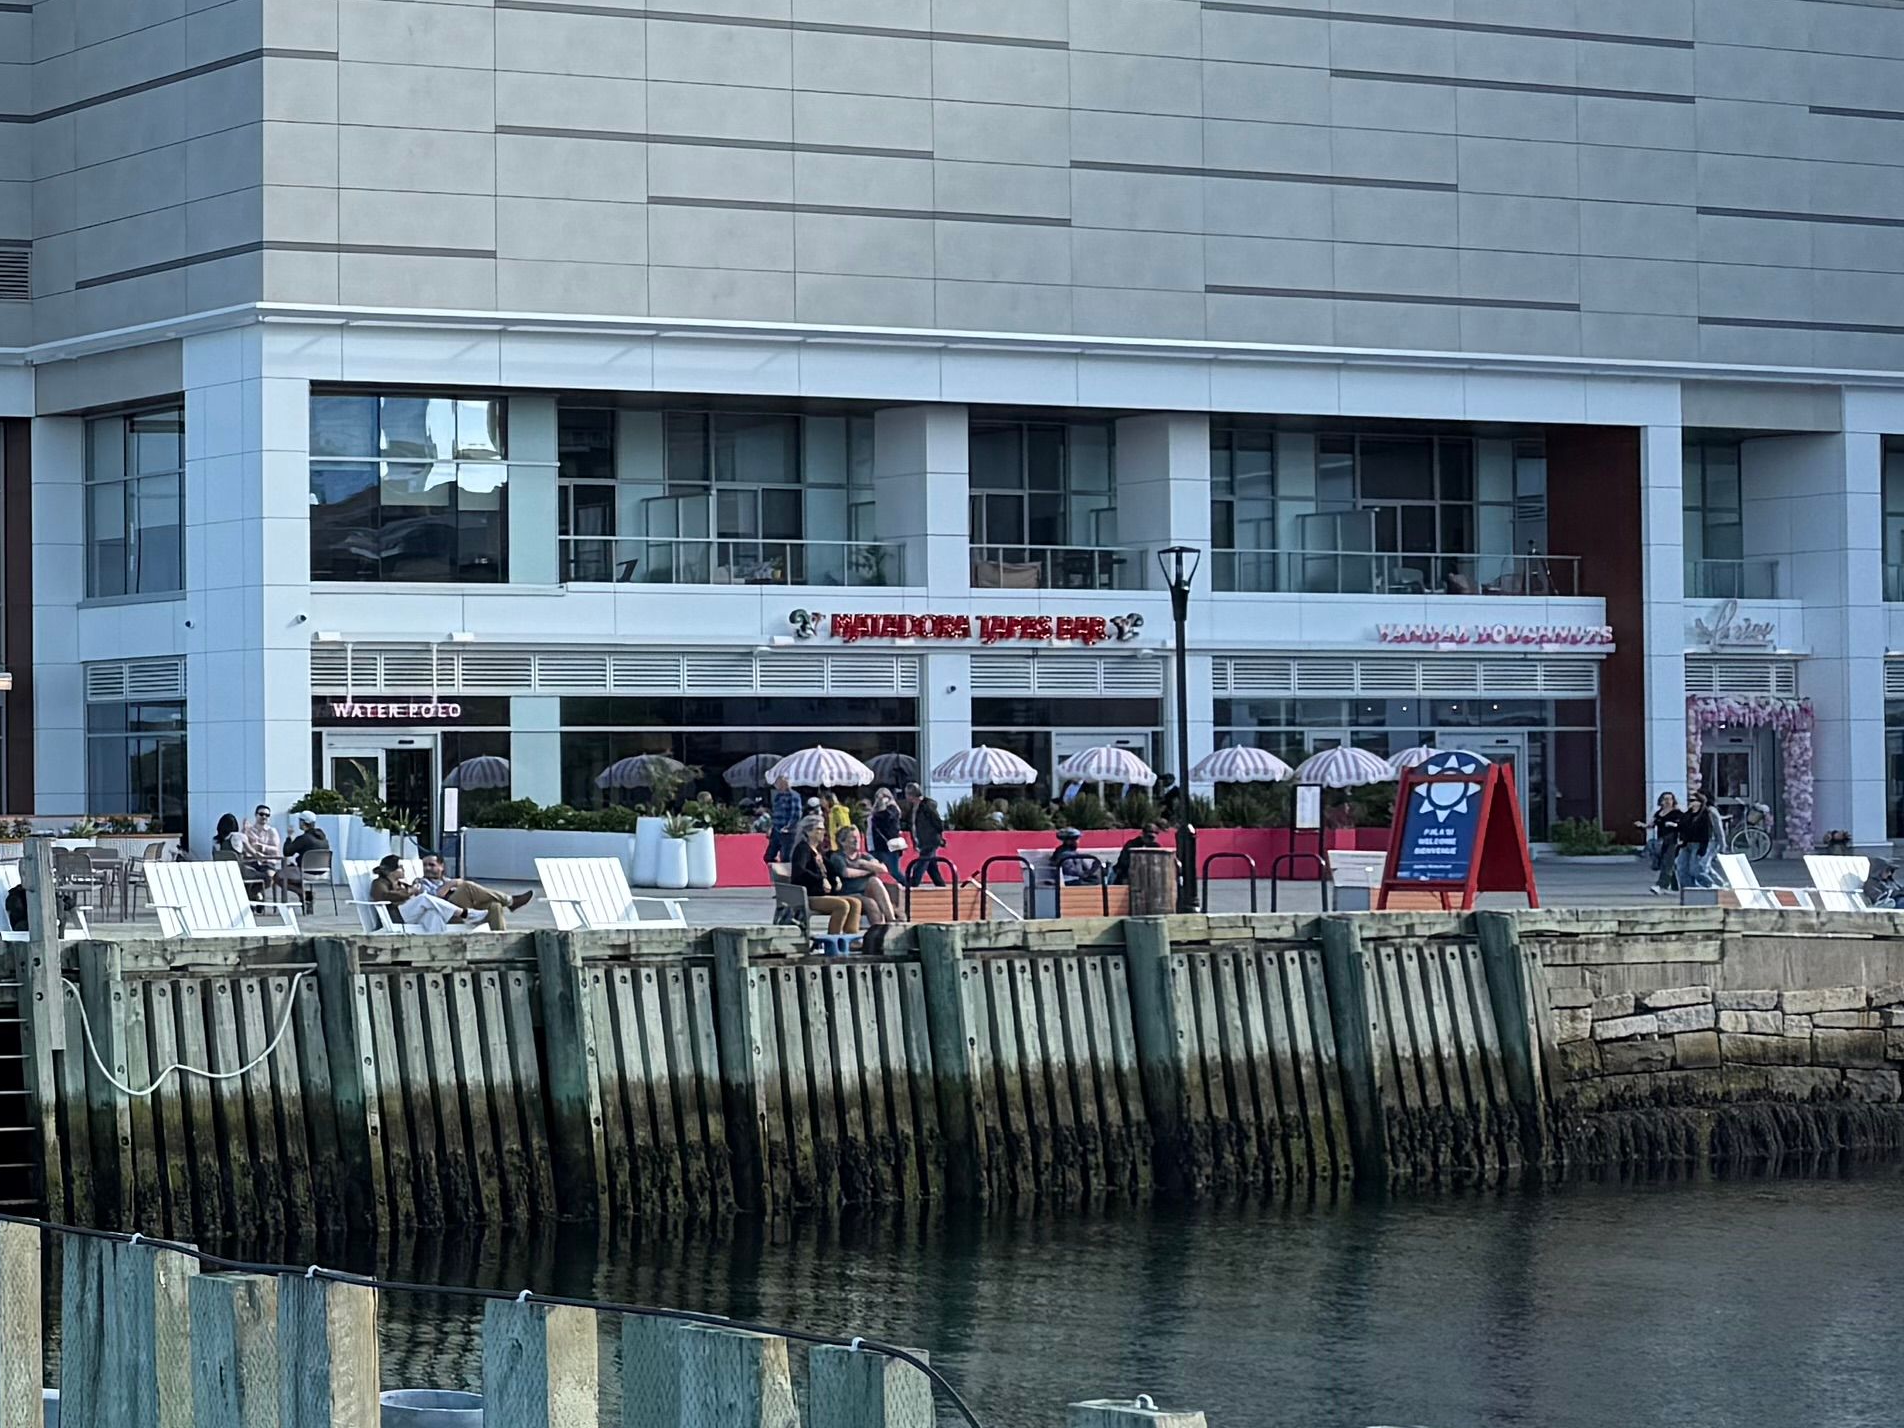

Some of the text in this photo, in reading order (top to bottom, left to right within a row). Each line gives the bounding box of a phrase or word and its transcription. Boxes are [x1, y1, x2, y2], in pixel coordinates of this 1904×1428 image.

[1055, 615, 1110, 645] BAR
[1378, 623, 1614, 644] VANDAL DOUGHNUTS
[332, 703, 461, 718] WATER POLO
